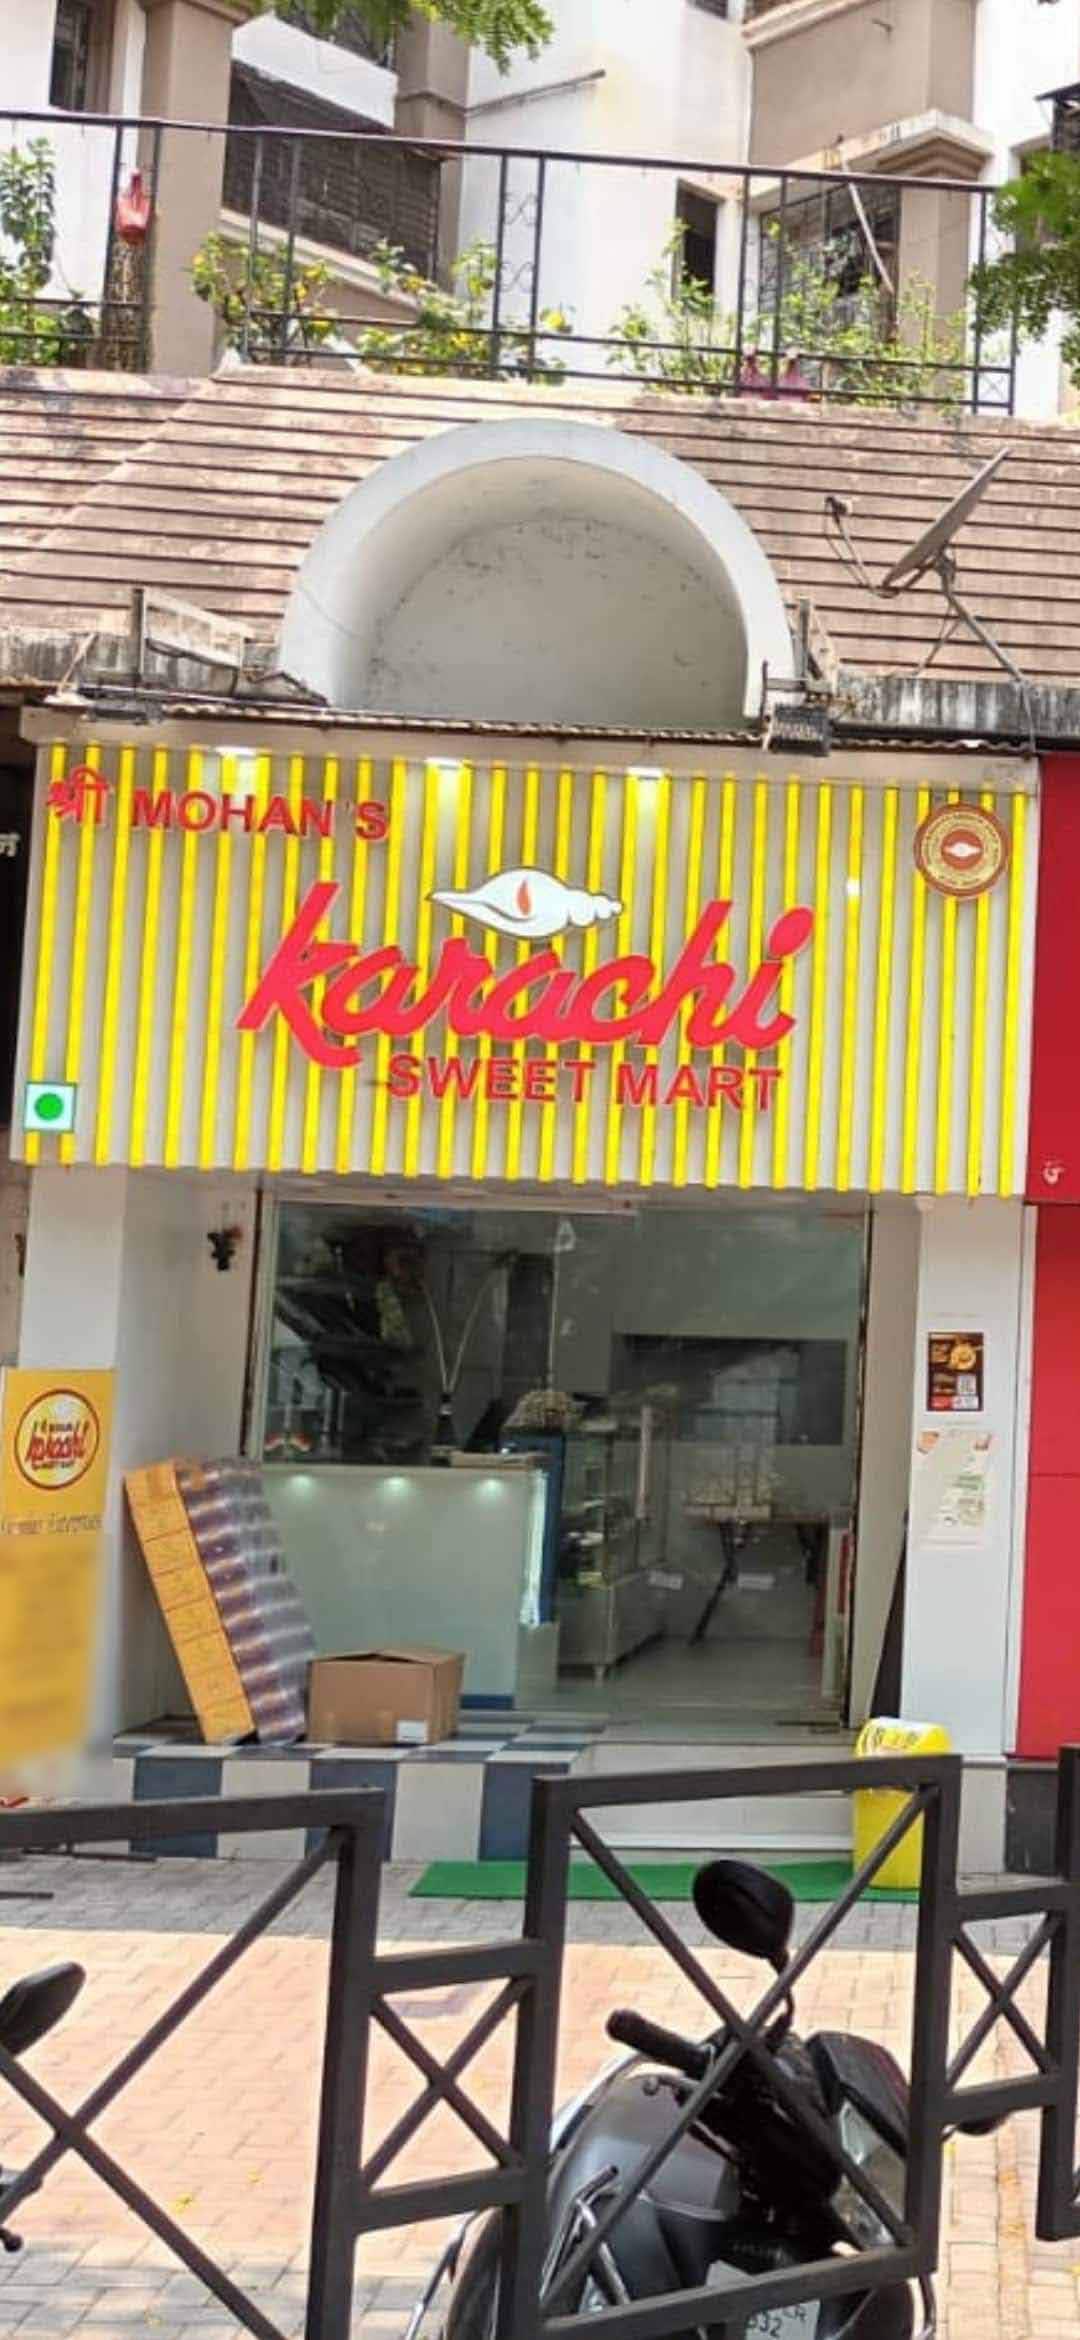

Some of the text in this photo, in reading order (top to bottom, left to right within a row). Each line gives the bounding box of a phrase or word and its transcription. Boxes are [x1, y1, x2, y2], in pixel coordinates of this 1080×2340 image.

[46, 764, 109, 824] श्री
[236, 880, 815, 1069] karachi
[386, 1053, 782, 1111] SWEET MART
